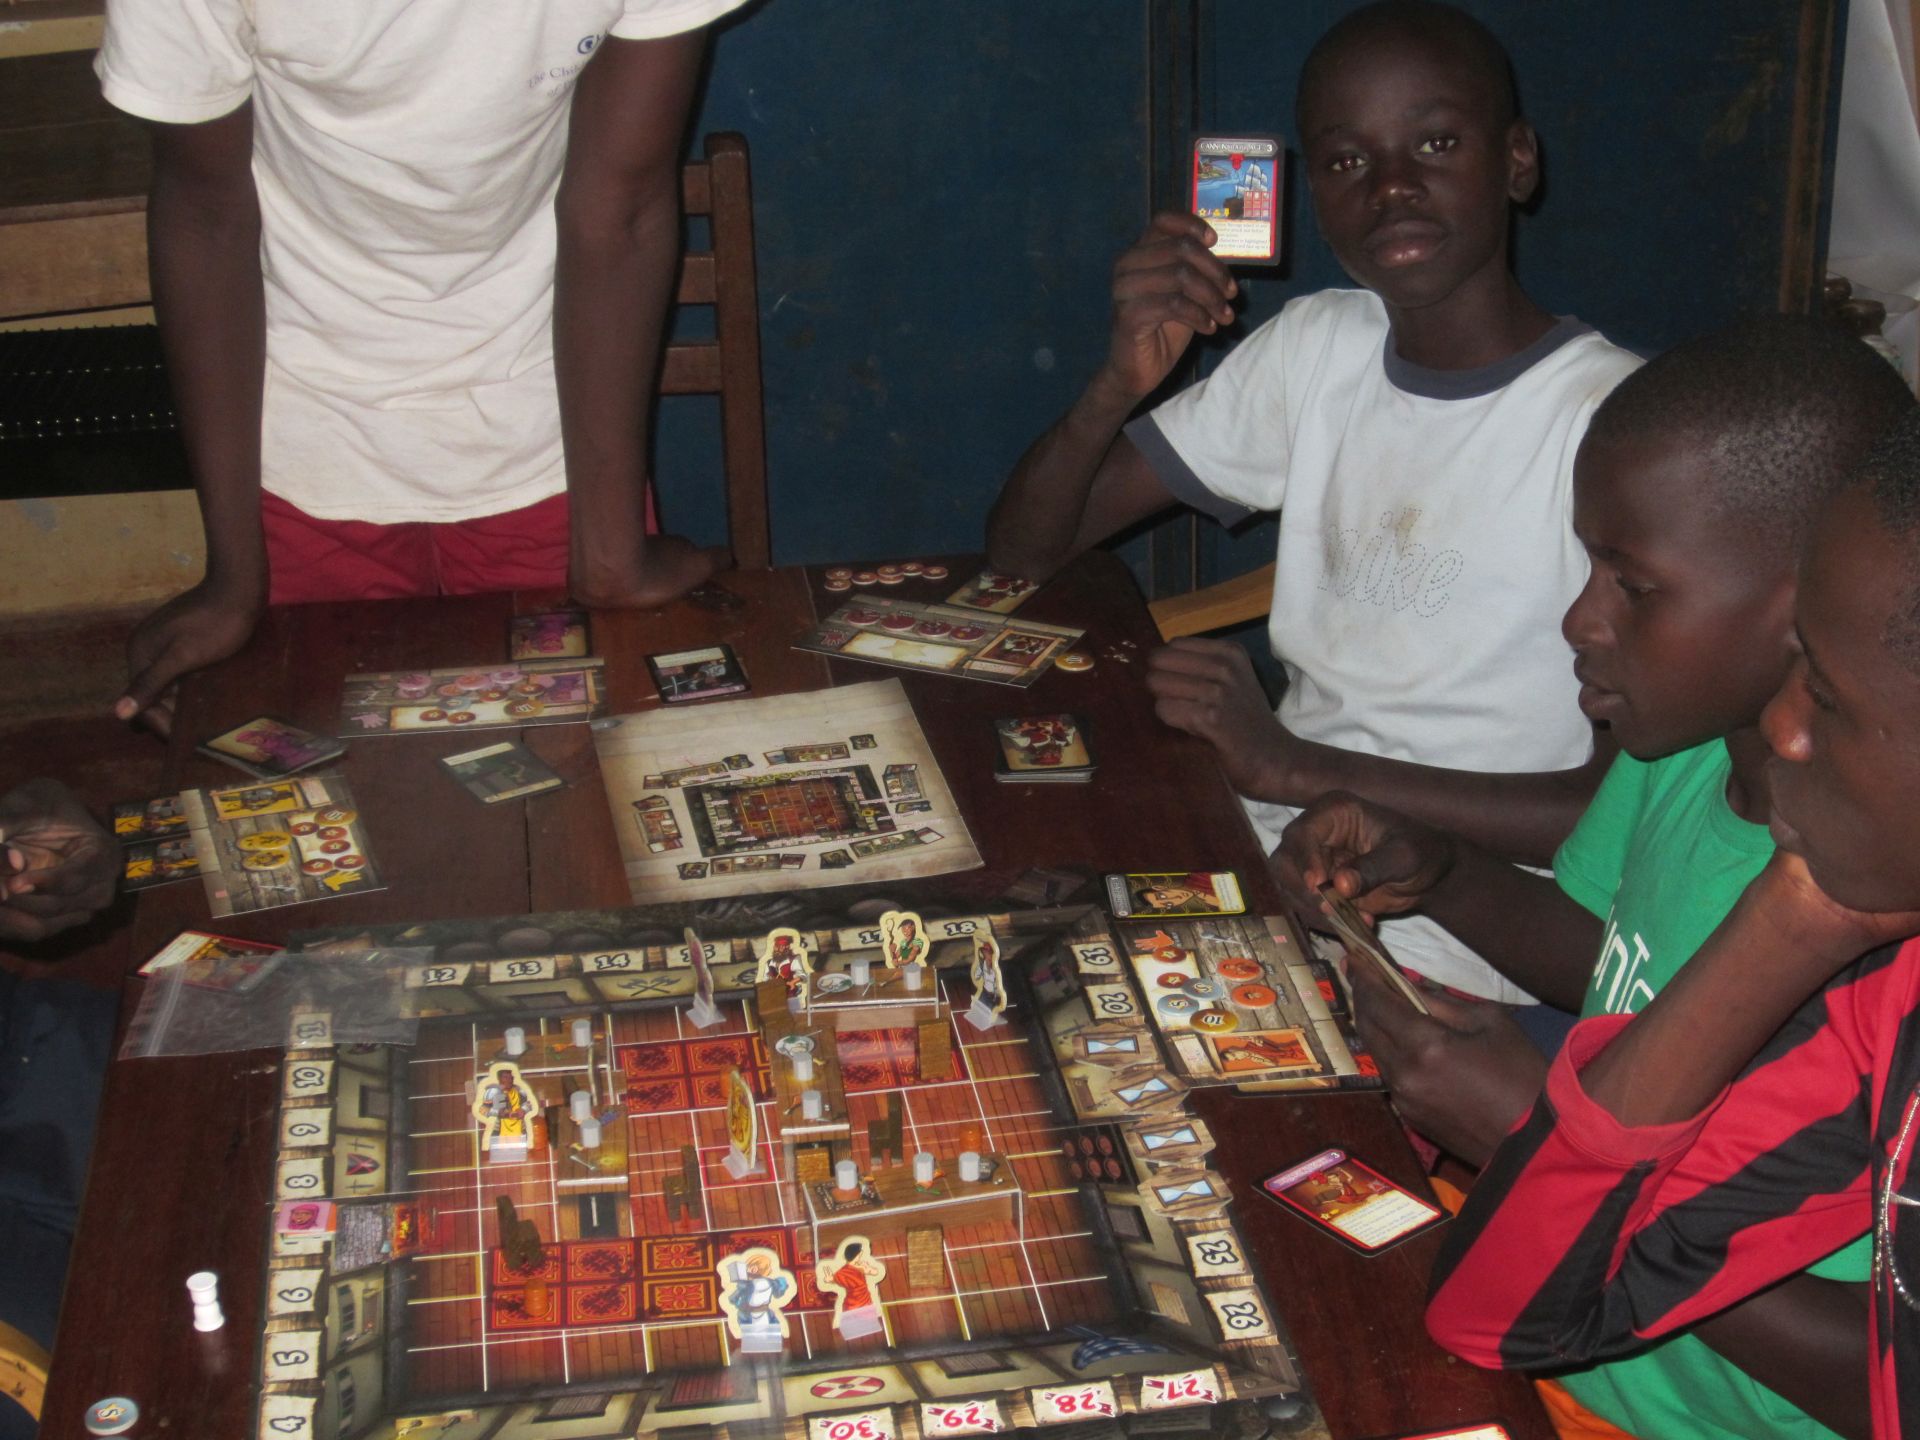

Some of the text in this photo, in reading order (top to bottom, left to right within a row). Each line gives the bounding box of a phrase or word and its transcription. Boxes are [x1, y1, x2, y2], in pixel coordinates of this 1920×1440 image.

[944, 920, 977, 936] 18
[594, 953, 630, 971] 14
[1079, 947, 1114, 967] 19
[424, 967, 457, 984] 12
[508, 960, 542, 977] 13
[1097, 992, 1134, 1014] 20
[292, 1066, 325, 1089] 10
[284, 1174, 319, 1190] 8
[1196, 1239, 1239, 1266] 25
[1220, 1301, 1263, 1330] 26
[272, 1349, 310, 1367] 5
[1166, 1377, 1201, 1400] 27
[1054, 1391, 1097, 1414] 28
[269, 1415, 307, 1434] 4
[942, 1406, 982, 1428] 29
[828, 1418, 875, 1440] 30
